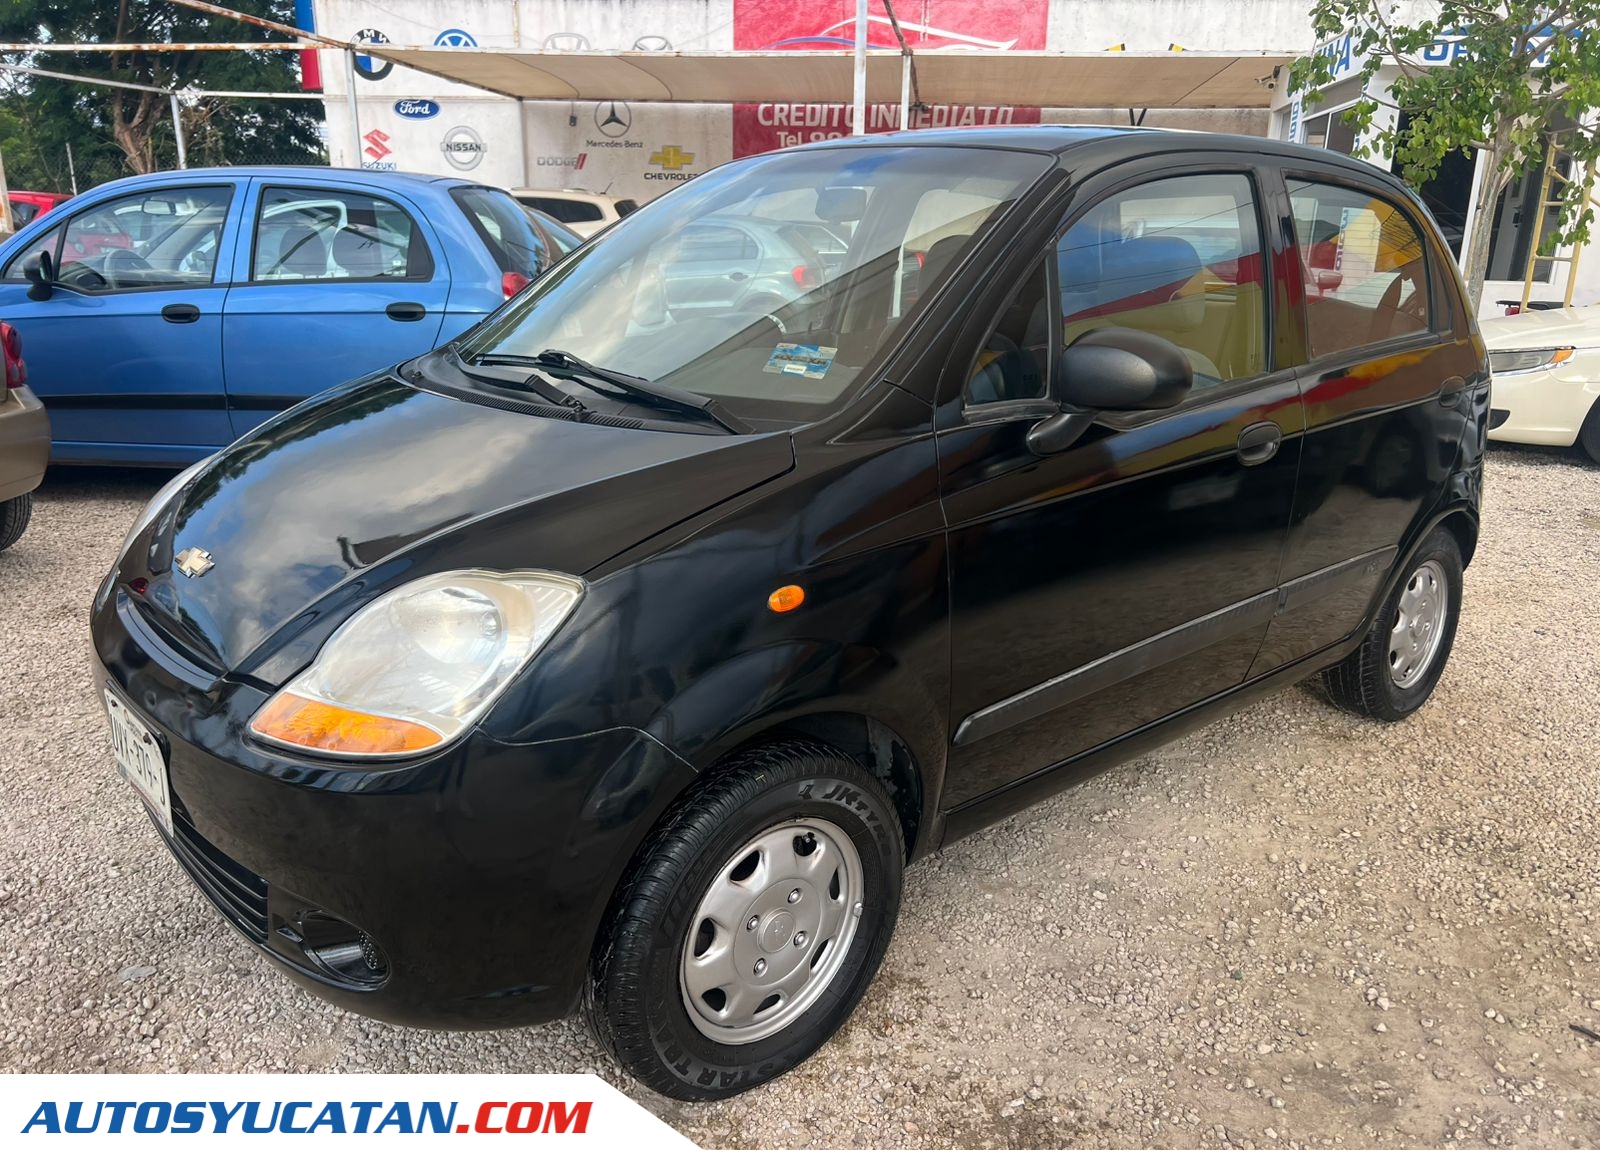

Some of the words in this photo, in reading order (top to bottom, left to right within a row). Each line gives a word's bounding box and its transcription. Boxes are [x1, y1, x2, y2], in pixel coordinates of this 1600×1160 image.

[399, 98, 431, 115] Ford
[446, 143, 482, 152] NISSAN
[362, 161, 398, 170] SUZUKI
[537, 156, 579, 167] DODGE
